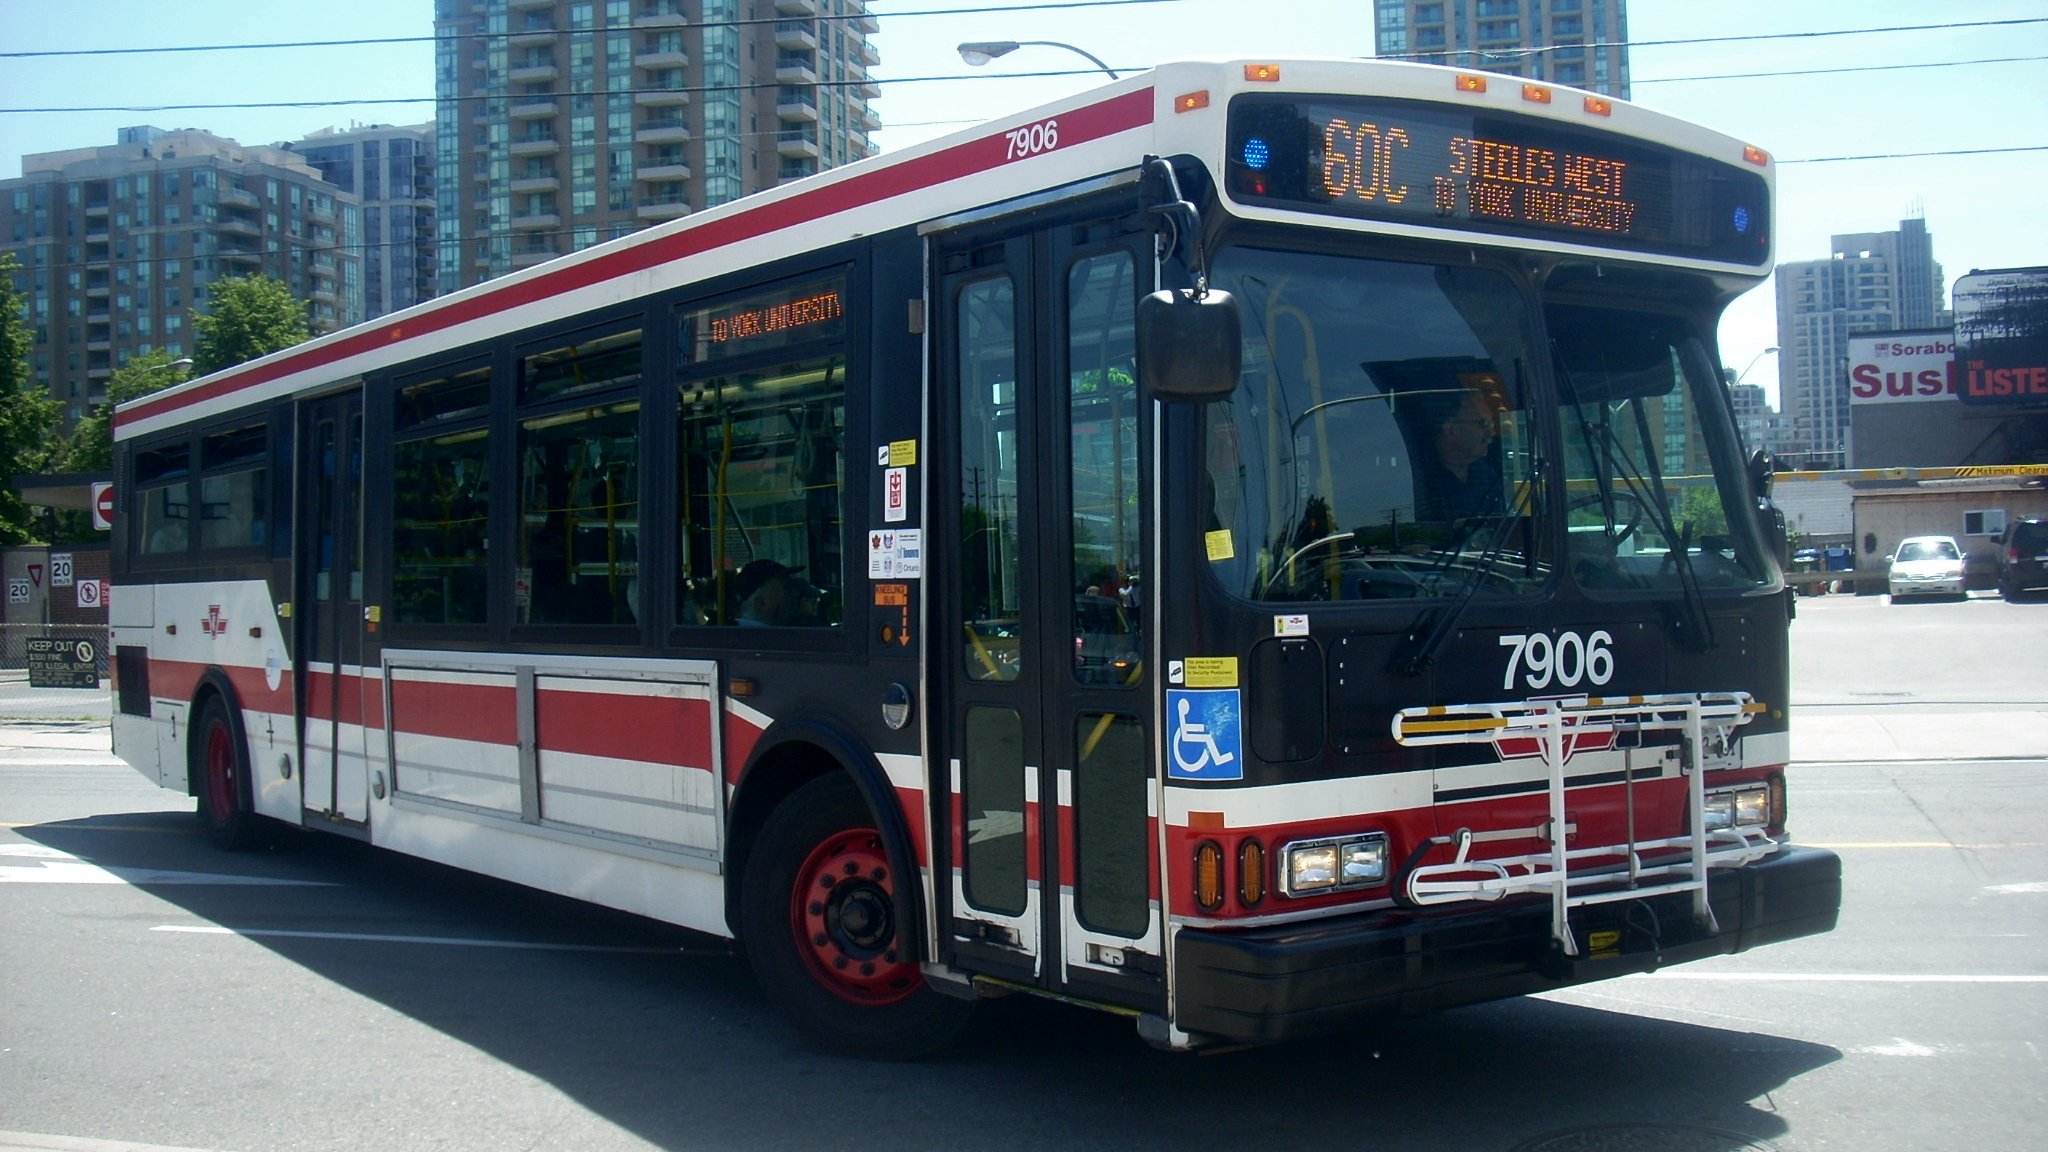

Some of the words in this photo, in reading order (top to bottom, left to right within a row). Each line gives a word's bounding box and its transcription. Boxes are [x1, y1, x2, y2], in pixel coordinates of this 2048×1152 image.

[1005, 120, 1058, 160] 7906
[1324, 118, 1409, 204] 60C
[1449, 137, 1556, 187] STEELES
[1564, 154, 1626, 197] WEST
[1434, 176, 1456, 209] TO
[1466, 181, 1515, 218] YORK
[1524, 188, 1635, 232] UNIVERSITY
[711, 318, 728, 343] TO
[730, 311, 762, 338] YORK
[1967, 360, 1984, 369] THE
[1968, 366, 2048, 397] LISTE
[53, 562, 71, 577] 20
[11, 585, 28, 597] 20
[28, 640, 53, 651] KEEP
[54, 641, 74, 652] OUT
[1499, 630, 1614, 690] 7906
[31, 662, 44, 670] FOR
[45, 662, 71, 670] ILLEGAL
[73, 662, 95, 671] ENTRY
